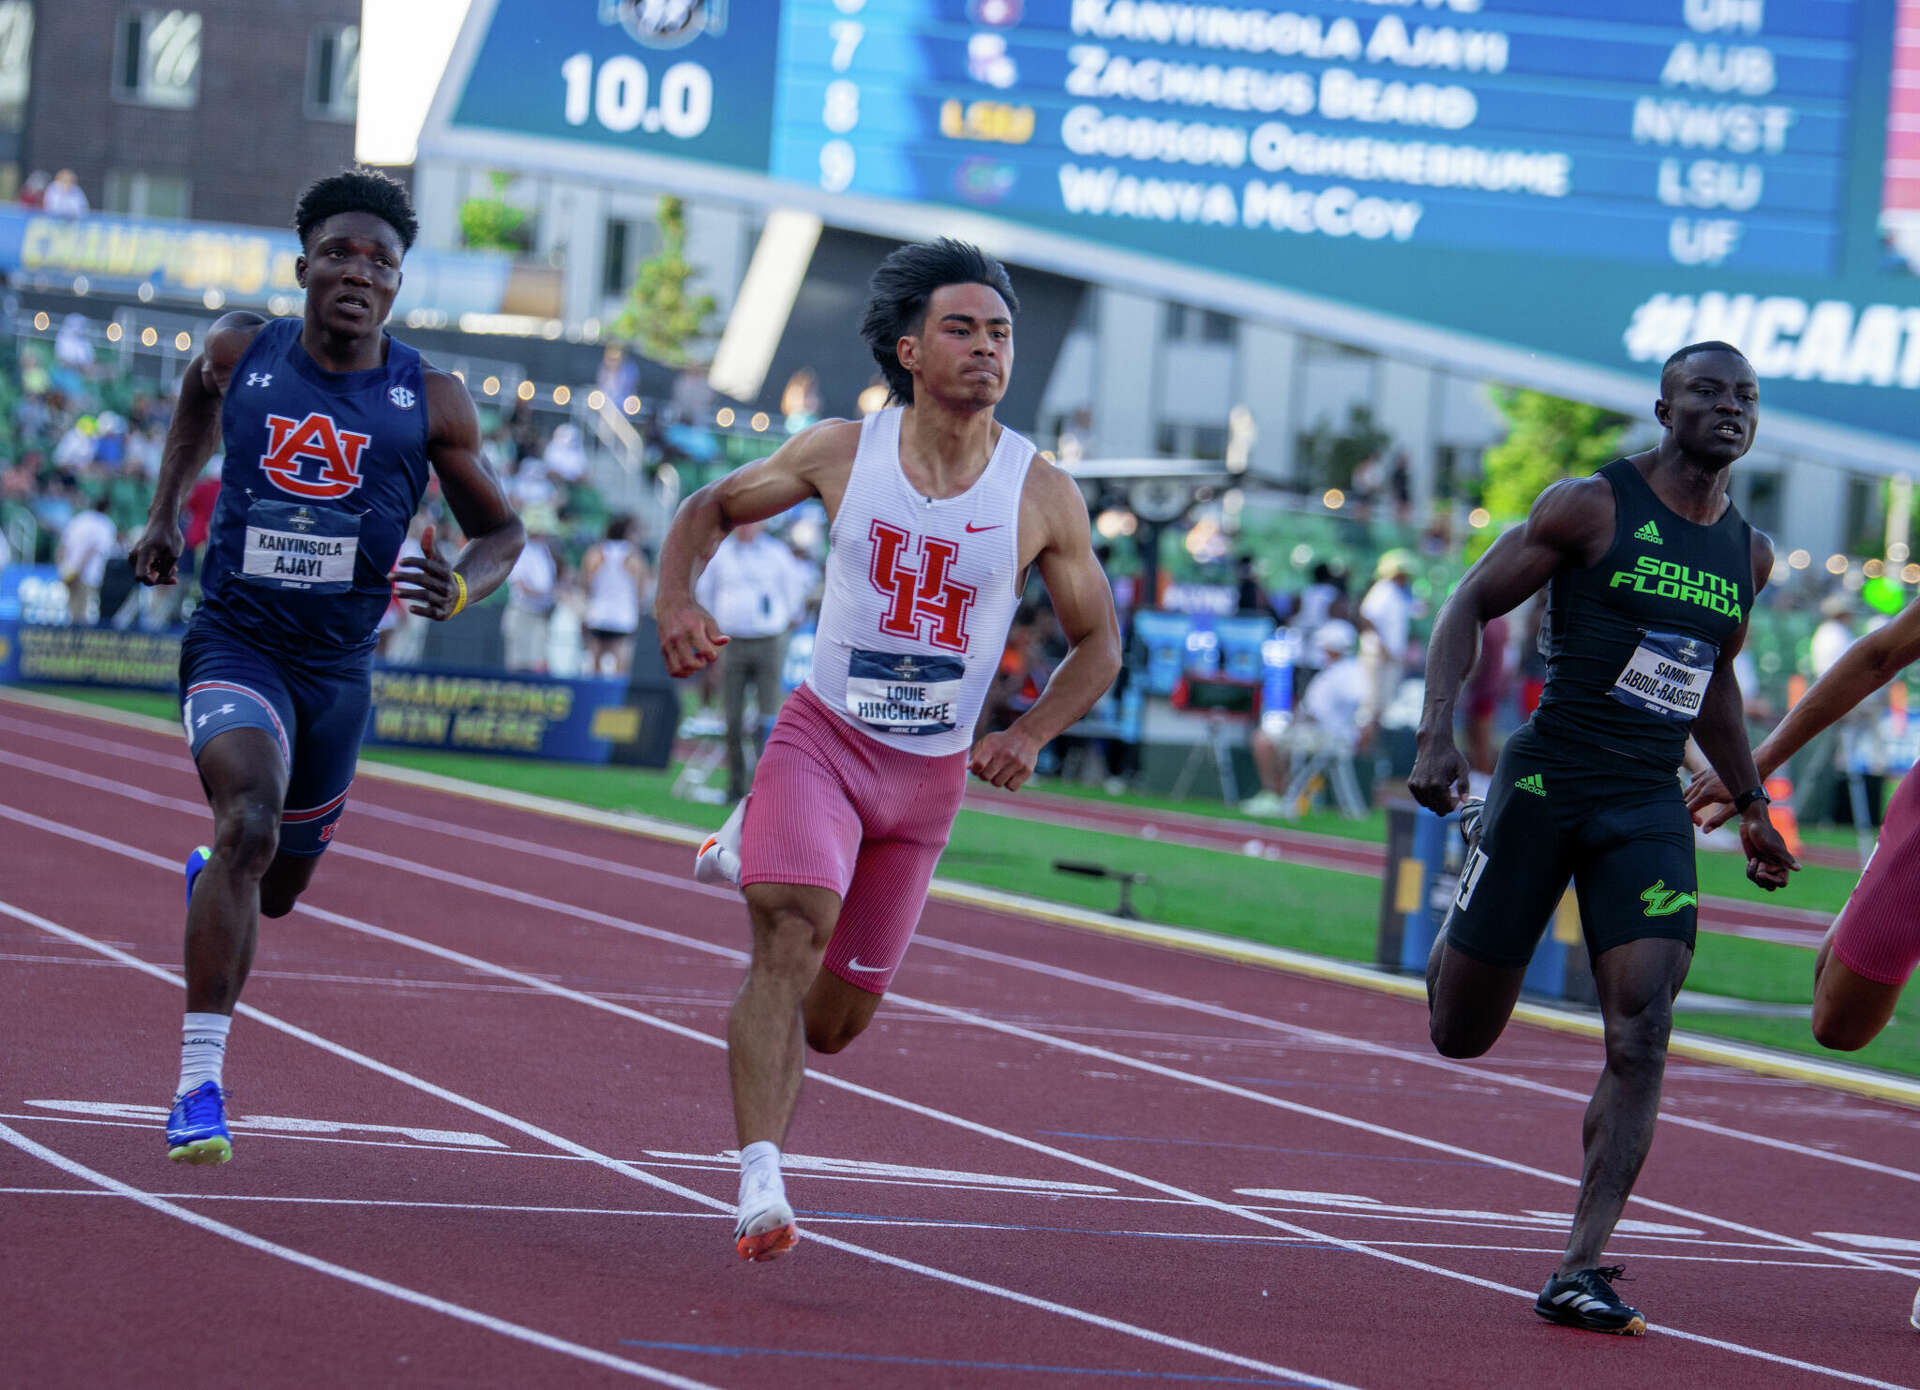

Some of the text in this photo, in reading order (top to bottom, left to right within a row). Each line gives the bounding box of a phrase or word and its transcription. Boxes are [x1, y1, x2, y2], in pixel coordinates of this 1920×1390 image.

[829, 20, 863, 72] 7
[1632, 96, 1795, 154] NWST
[1660, 41, 1777, 96] AUB
[561, 52, 714, 138] 10.0
[822, 79, 860, 134] 8
[1657, 156, 1765, 211] LSU
[819, 139, 857, 194] 9
[1668, 216, 1745, 267] UF
[389, 385, 416, 409] SEC
[259, 532, 342, 557] KANYINSOLA
[1633, 530, 1664, 546] adidas
[273, 555, 323, 577] AJAYI
[868, 518, 977, 653] UH
[1634, 555, 1738, 601] SOUTH
[1609, 571, 1742, 624] FLORIDA
[886, 684, 926, 702] LOUIE
[1620, 667, 1701, 710] ABDUL-RASHEED
[857, 702, 950, 722] HINCHLIFFE
[1513, 779, 1548, 798] adidas
